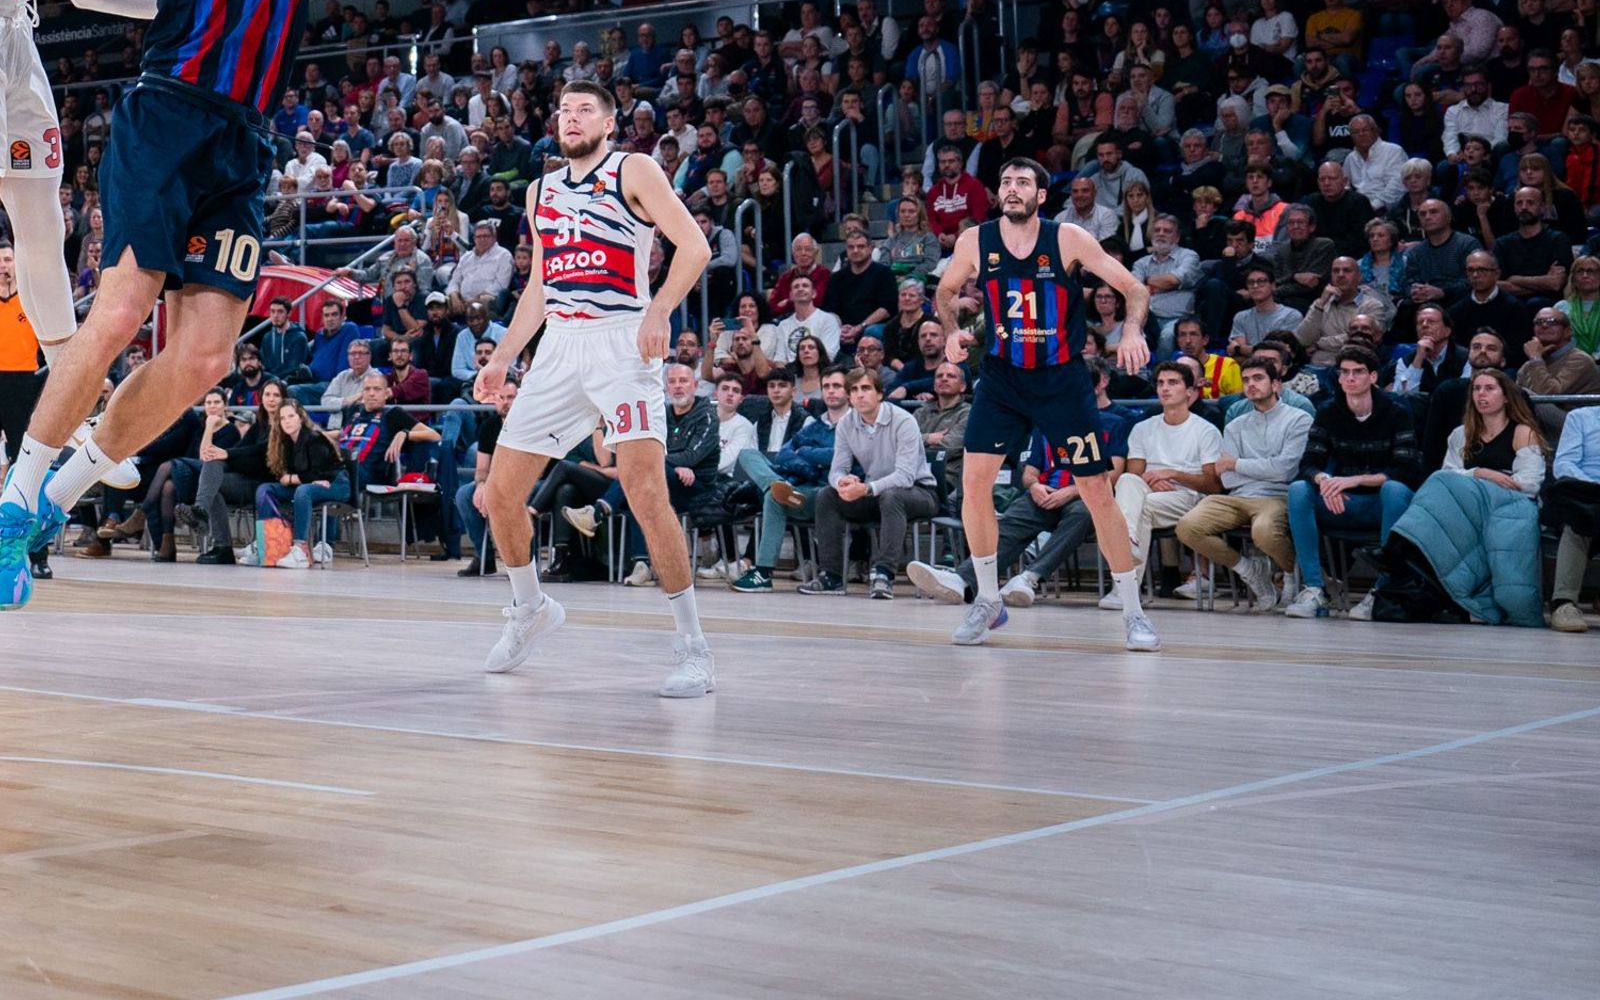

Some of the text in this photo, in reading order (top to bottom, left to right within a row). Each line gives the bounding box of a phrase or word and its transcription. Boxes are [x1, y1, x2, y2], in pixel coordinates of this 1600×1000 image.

[554, 212, 581, 246] 31
[215, 228, 260, 282] 10
[1006, 290, 1038, 320] 21
[616, 401, 650, 434] 31
[1067, 431, 1101, 465] 21
